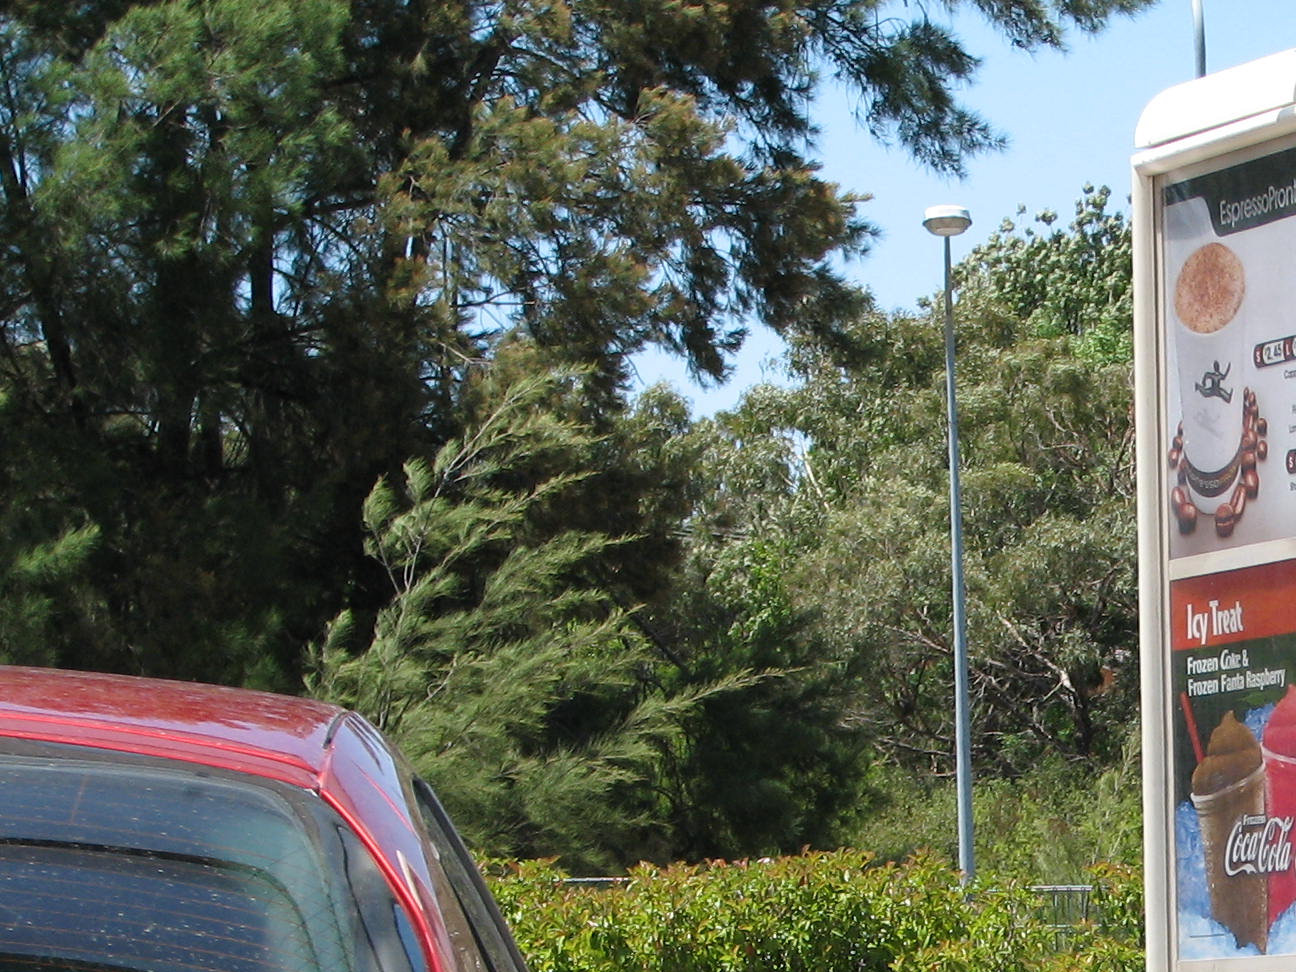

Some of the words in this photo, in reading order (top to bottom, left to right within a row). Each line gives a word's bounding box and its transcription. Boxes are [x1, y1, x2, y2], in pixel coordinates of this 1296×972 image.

[1255, 353, 1262, 364] S
[1187, 603, 1209, 645] Icy
[1209, 600, 1244, 636] Treat
[1187, 655, 1218, 675] Frozen
[1220, 648, 1241, 671] Coke
[1242, 648, 1249, 667] &
[1187, 678, 1219, 697] Frozen
[1221, 672, 1245, 693] Fanta
[1246, 668, 1287, 691] Raspberry
